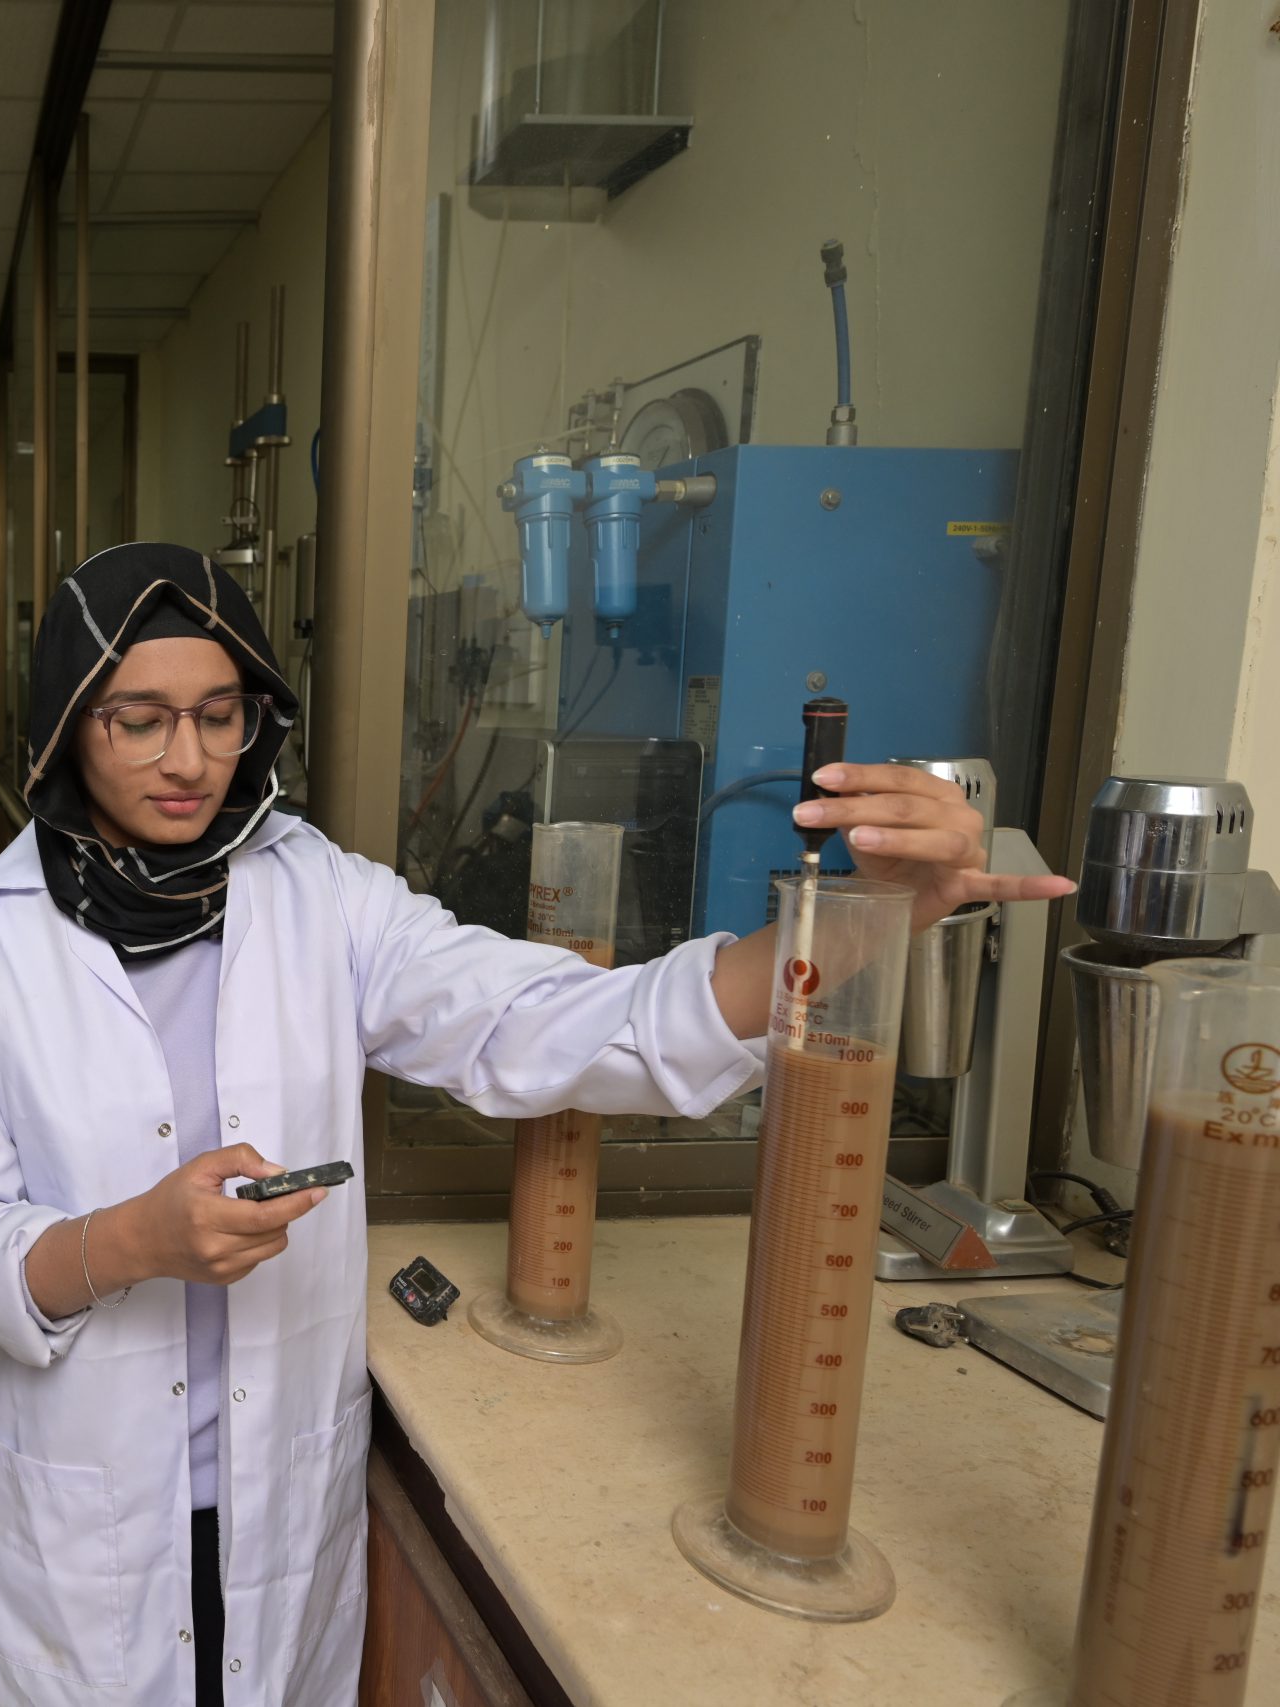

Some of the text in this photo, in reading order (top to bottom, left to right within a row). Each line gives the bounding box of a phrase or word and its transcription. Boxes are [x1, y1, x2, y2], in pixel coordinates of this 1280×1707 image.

[568, 939, 594, 950] 1000
[807, 1032, 850, 1046] ±10ml
[838, 1049, 874, 1063] 1000
[840, 1102, 869, 1115] 900
[1221, 1107, 1276, 1127] 20°C
[1203, 1120, 1280, 1149] Ex m
[835, 1153, 863, 1167] 800
[558, 1168, 577, 1178] 400
[555, 1205, 575, 1215] 300
[831, 1204, 858, 1217] 700
[901, 1205, 932, 1231] Stirrer
[553, 1241, 572, 1251] 200
[825, 1255, 853, 1268] 600
[551, 1277, 570, 1287] 100
[820, 1304, 848, 1318] 500
[815, 1354, 842, 1367] 400
[1261, 1346, 1280, 1366] 70
[810, 1403, 837, 1416] 300
[805, 1451, 832, 1465] 200
[801, 1498, 827, 1512] 100
[1223, 1591, 1255, 1610] 300
[1214, 1652, 1246, 1671] 200
